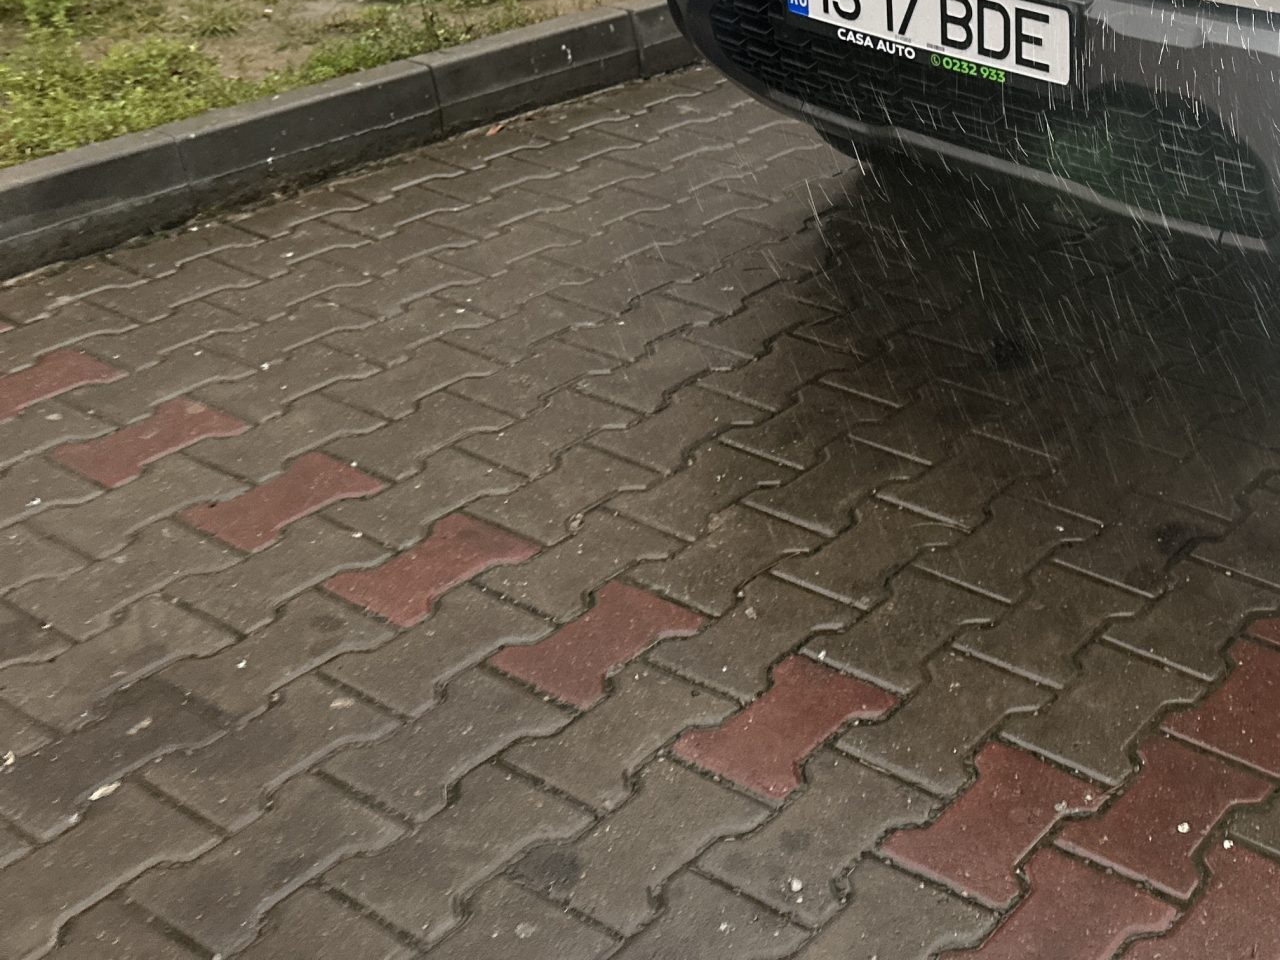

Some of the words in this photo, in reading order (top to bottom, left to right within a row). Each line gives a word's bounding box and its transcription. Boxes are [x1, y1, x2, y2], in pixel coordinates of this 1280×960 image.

[837, 28, 874, 52] CASA
[876, 39, 916, 60] AUTO
[943, 58, 978, 78] 0232
[980, 67, 1006, 83] 933
